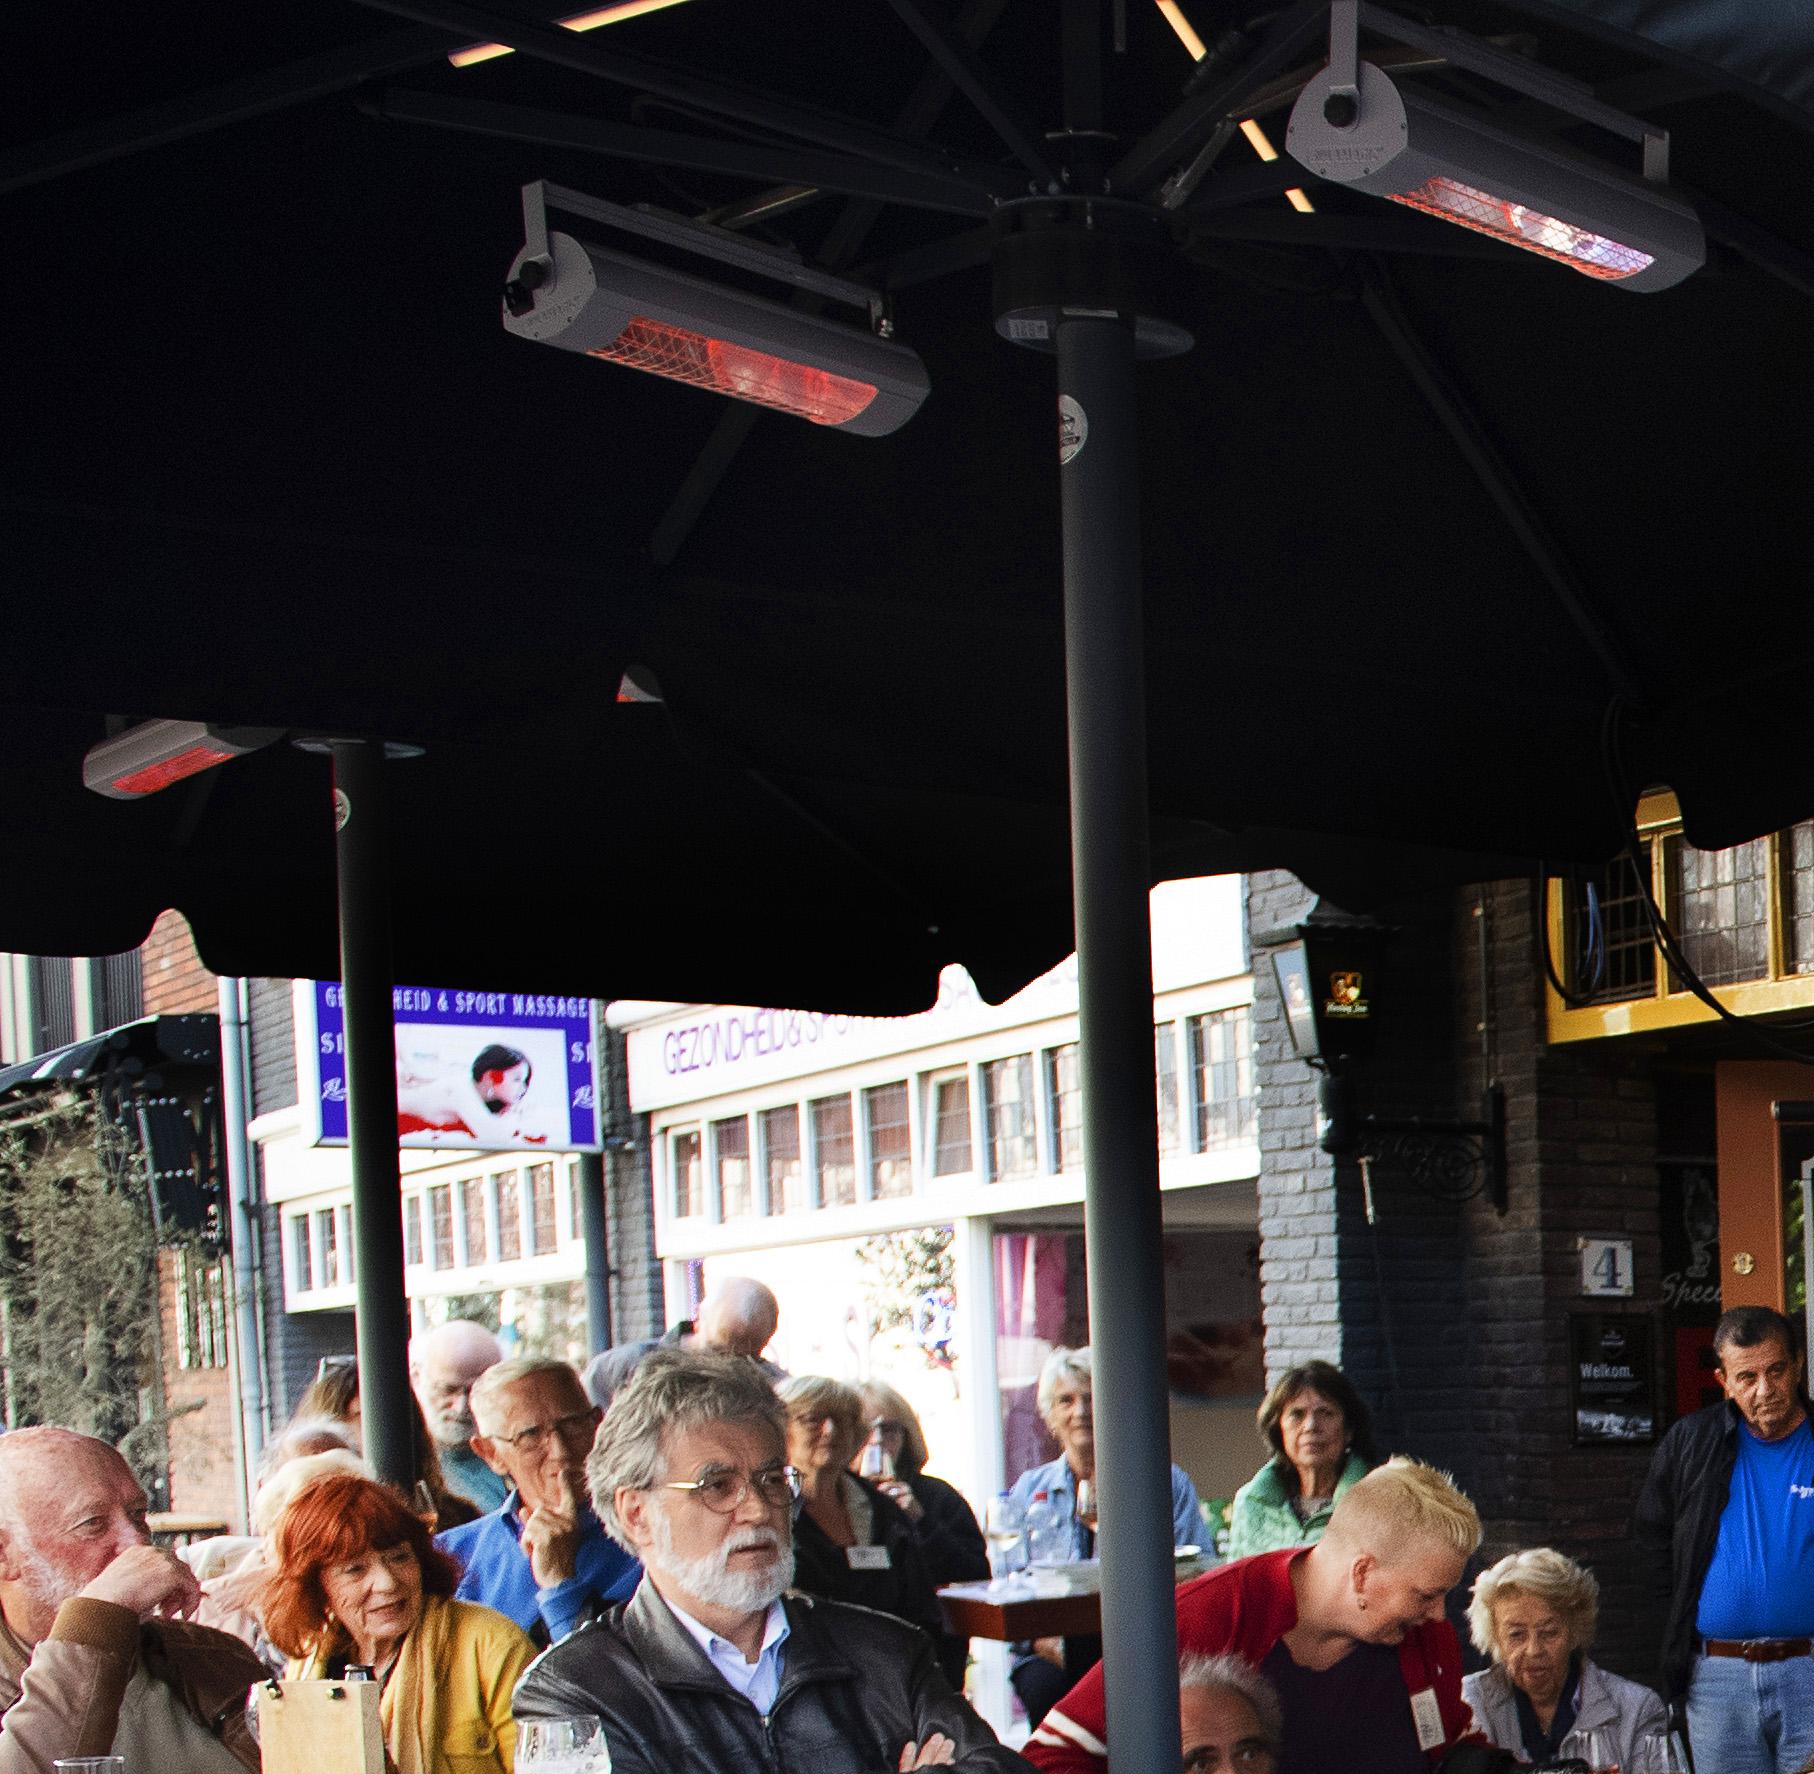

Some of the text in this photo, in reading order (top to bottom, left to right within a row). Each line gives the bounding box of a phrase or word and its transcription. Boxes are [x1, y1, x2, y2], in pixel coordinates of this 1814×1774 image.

[437, 990, 449, 1012] &
[455, 991, 506, 1016] SPORT
[512, 993, 589, 1018] MASSAGE
[1592, 1247, 1623, 1289] 4
[1580, 1363, 1634, 1379] Welkom.
